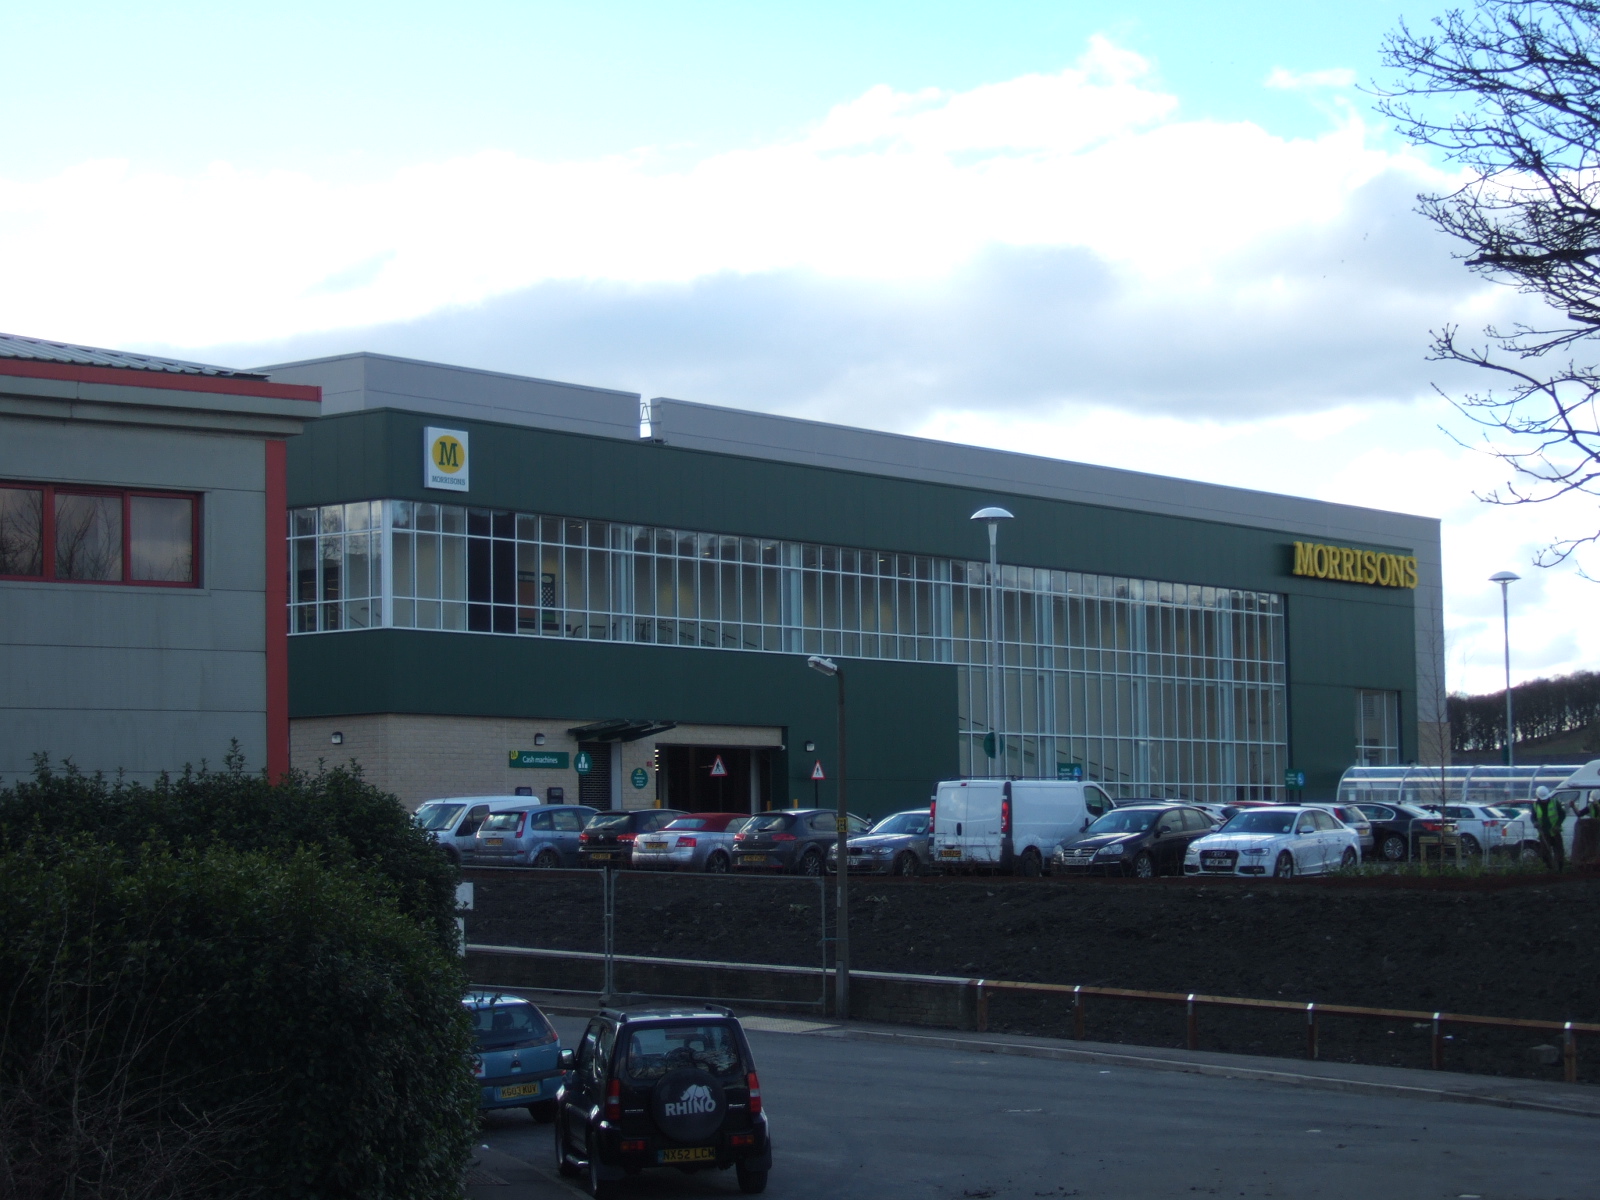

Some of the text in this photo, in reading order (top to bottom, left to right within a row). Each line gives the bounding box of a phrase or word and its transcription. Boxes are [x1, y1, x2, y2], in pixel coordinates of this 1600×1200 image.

[438, 441, 459, 467] M
[432, 475, 466, 486] MORRISONS
[1293, 541, 1418, 589] MORRISONS
[522, 755, 558, 764] Cash machines
[665, 1099, 716, 1116] RHINO
[663, 1149, 690, 1160] NX52
